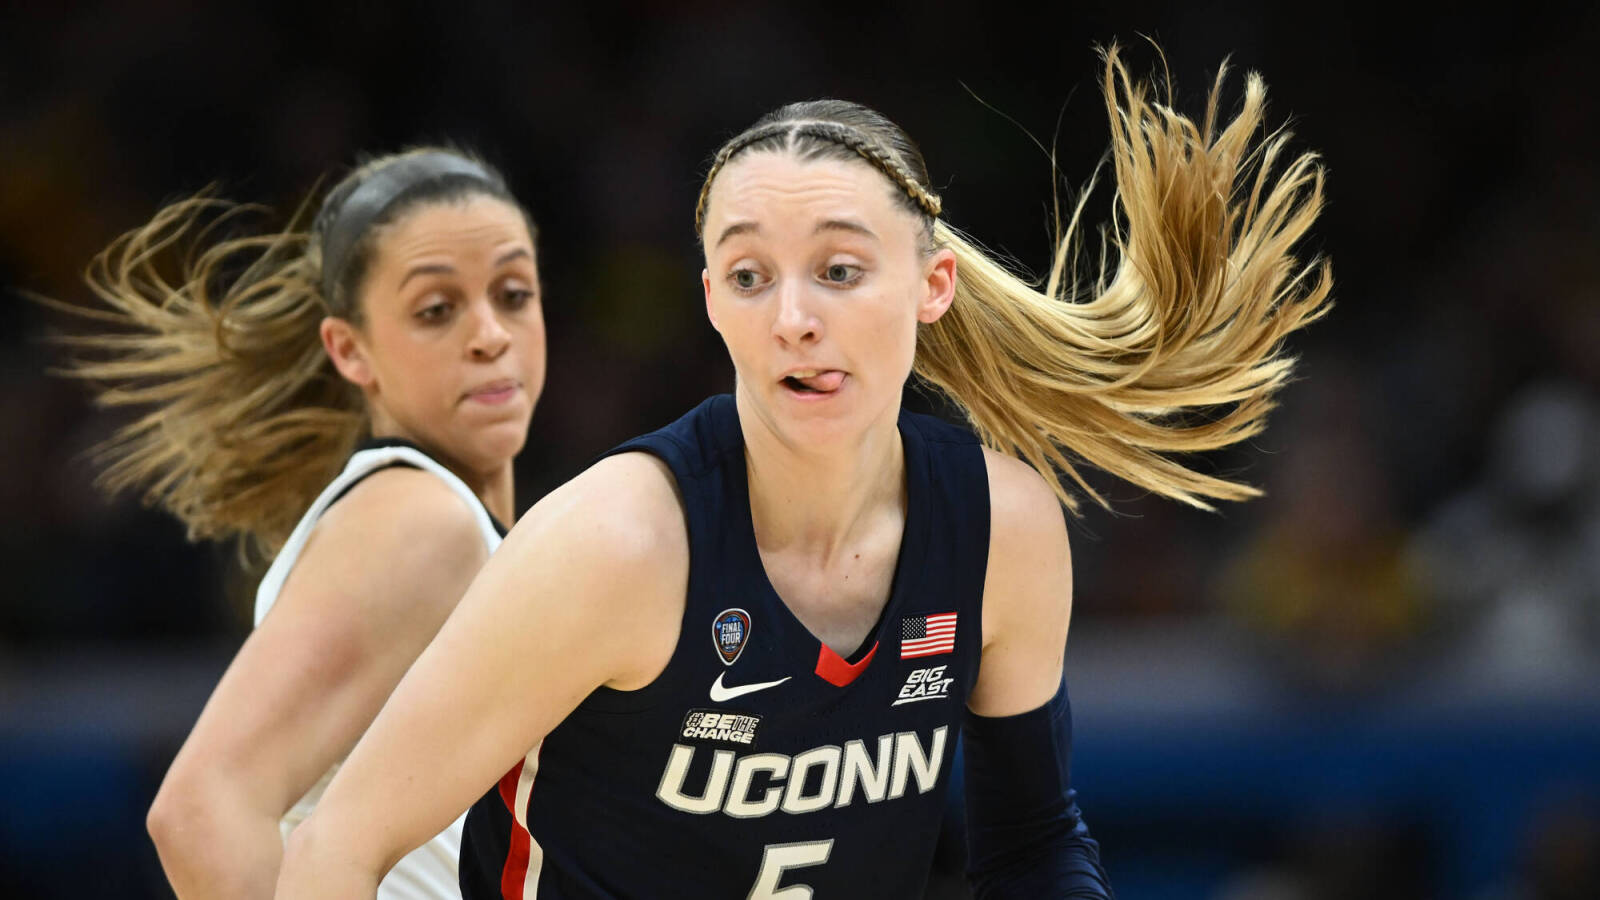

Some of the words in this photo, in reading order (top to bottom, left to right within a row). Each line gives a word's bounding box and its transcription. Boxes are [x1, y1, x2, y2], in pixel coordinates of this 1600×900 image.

[722, 621, 741, 634] FINAL
[721, 632, 741, 645] FOUR
[906, 665, 948, 684] BIG
[898, 678, 954, 698] EAST
[683, 727, 754, 744] CHANGE
[656, 725, 948, 818] UCONN
